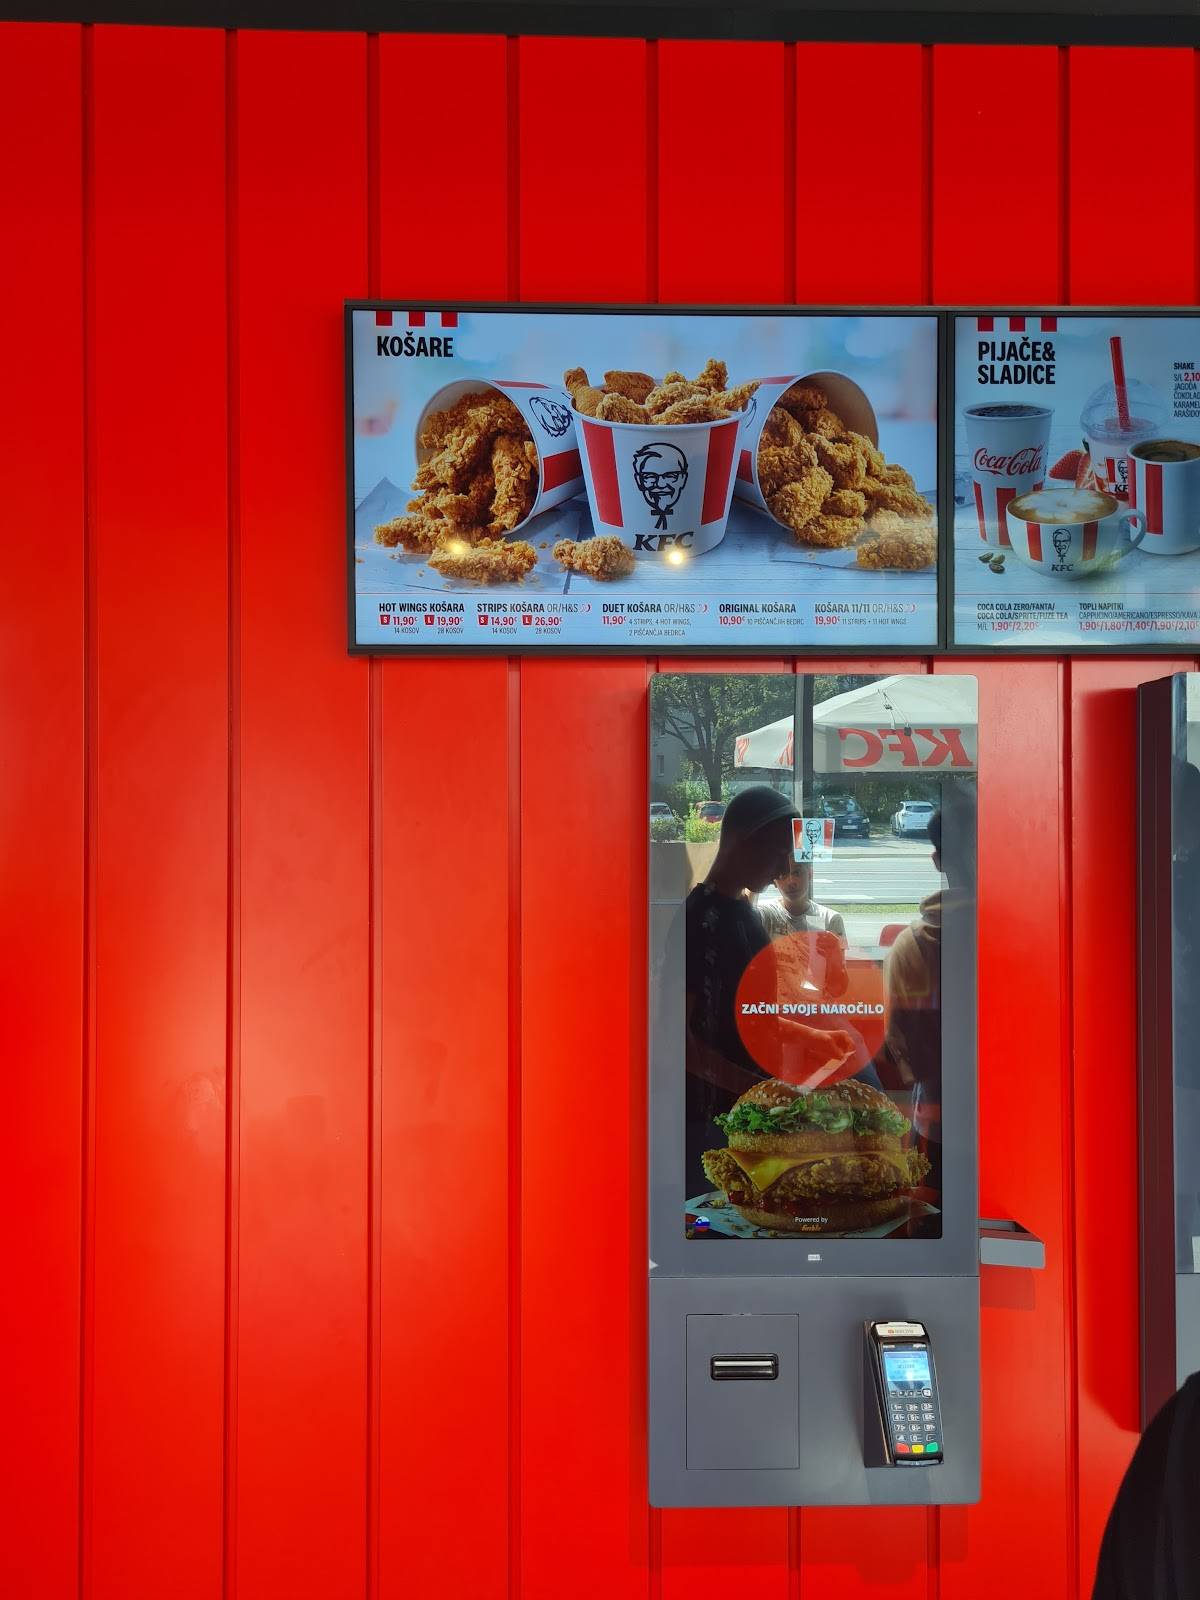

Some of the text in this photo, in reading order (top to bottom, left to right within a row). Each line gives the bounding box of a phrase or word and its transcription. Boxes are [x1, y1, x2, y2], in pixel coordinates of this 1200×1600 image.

[377, 331, 453, 357] KOŠARE
[978, 337, 1056, 362] PIJAČE&
[1174, 362, 1194, 370] SHAKE
[978, 365, 1056, 385] SLADICE
[1184, 372, 1200, 382] 2,10
[1174, 382, 1197, 390] JAGODA
[1174, 391, 1200, 400] ČOKOLAD
[1174, 409, 1200, 418] ARAŠIDO
[974, 444, 1044, 476] Coca-Cola
[1115, 484, 1128, 492] KF
[632, 531, 694, 552] KFC
[1051, 564, 1074, 572] KFC
[379, 602, 464, 612] HOT WINGS KOŠARA
[477, 602, 578, 613] STRIPS KOŠARA OR/H&S
[602, 602, 696, 613] DUET KOŠARA OR/H&S
[720, 602, 796, 612] ORIGINAL KOŠARA
[815, 602, 904, 613] KOŠARA 11/11 OR/H&S
[978, 612, 994, 620] COCA
[1056, 612, 1068, 620] TEA
[742, 1002, 884, 1016] ZAČNI SVOJE NAROČILO
[820, 1216, 828, 1224] by
